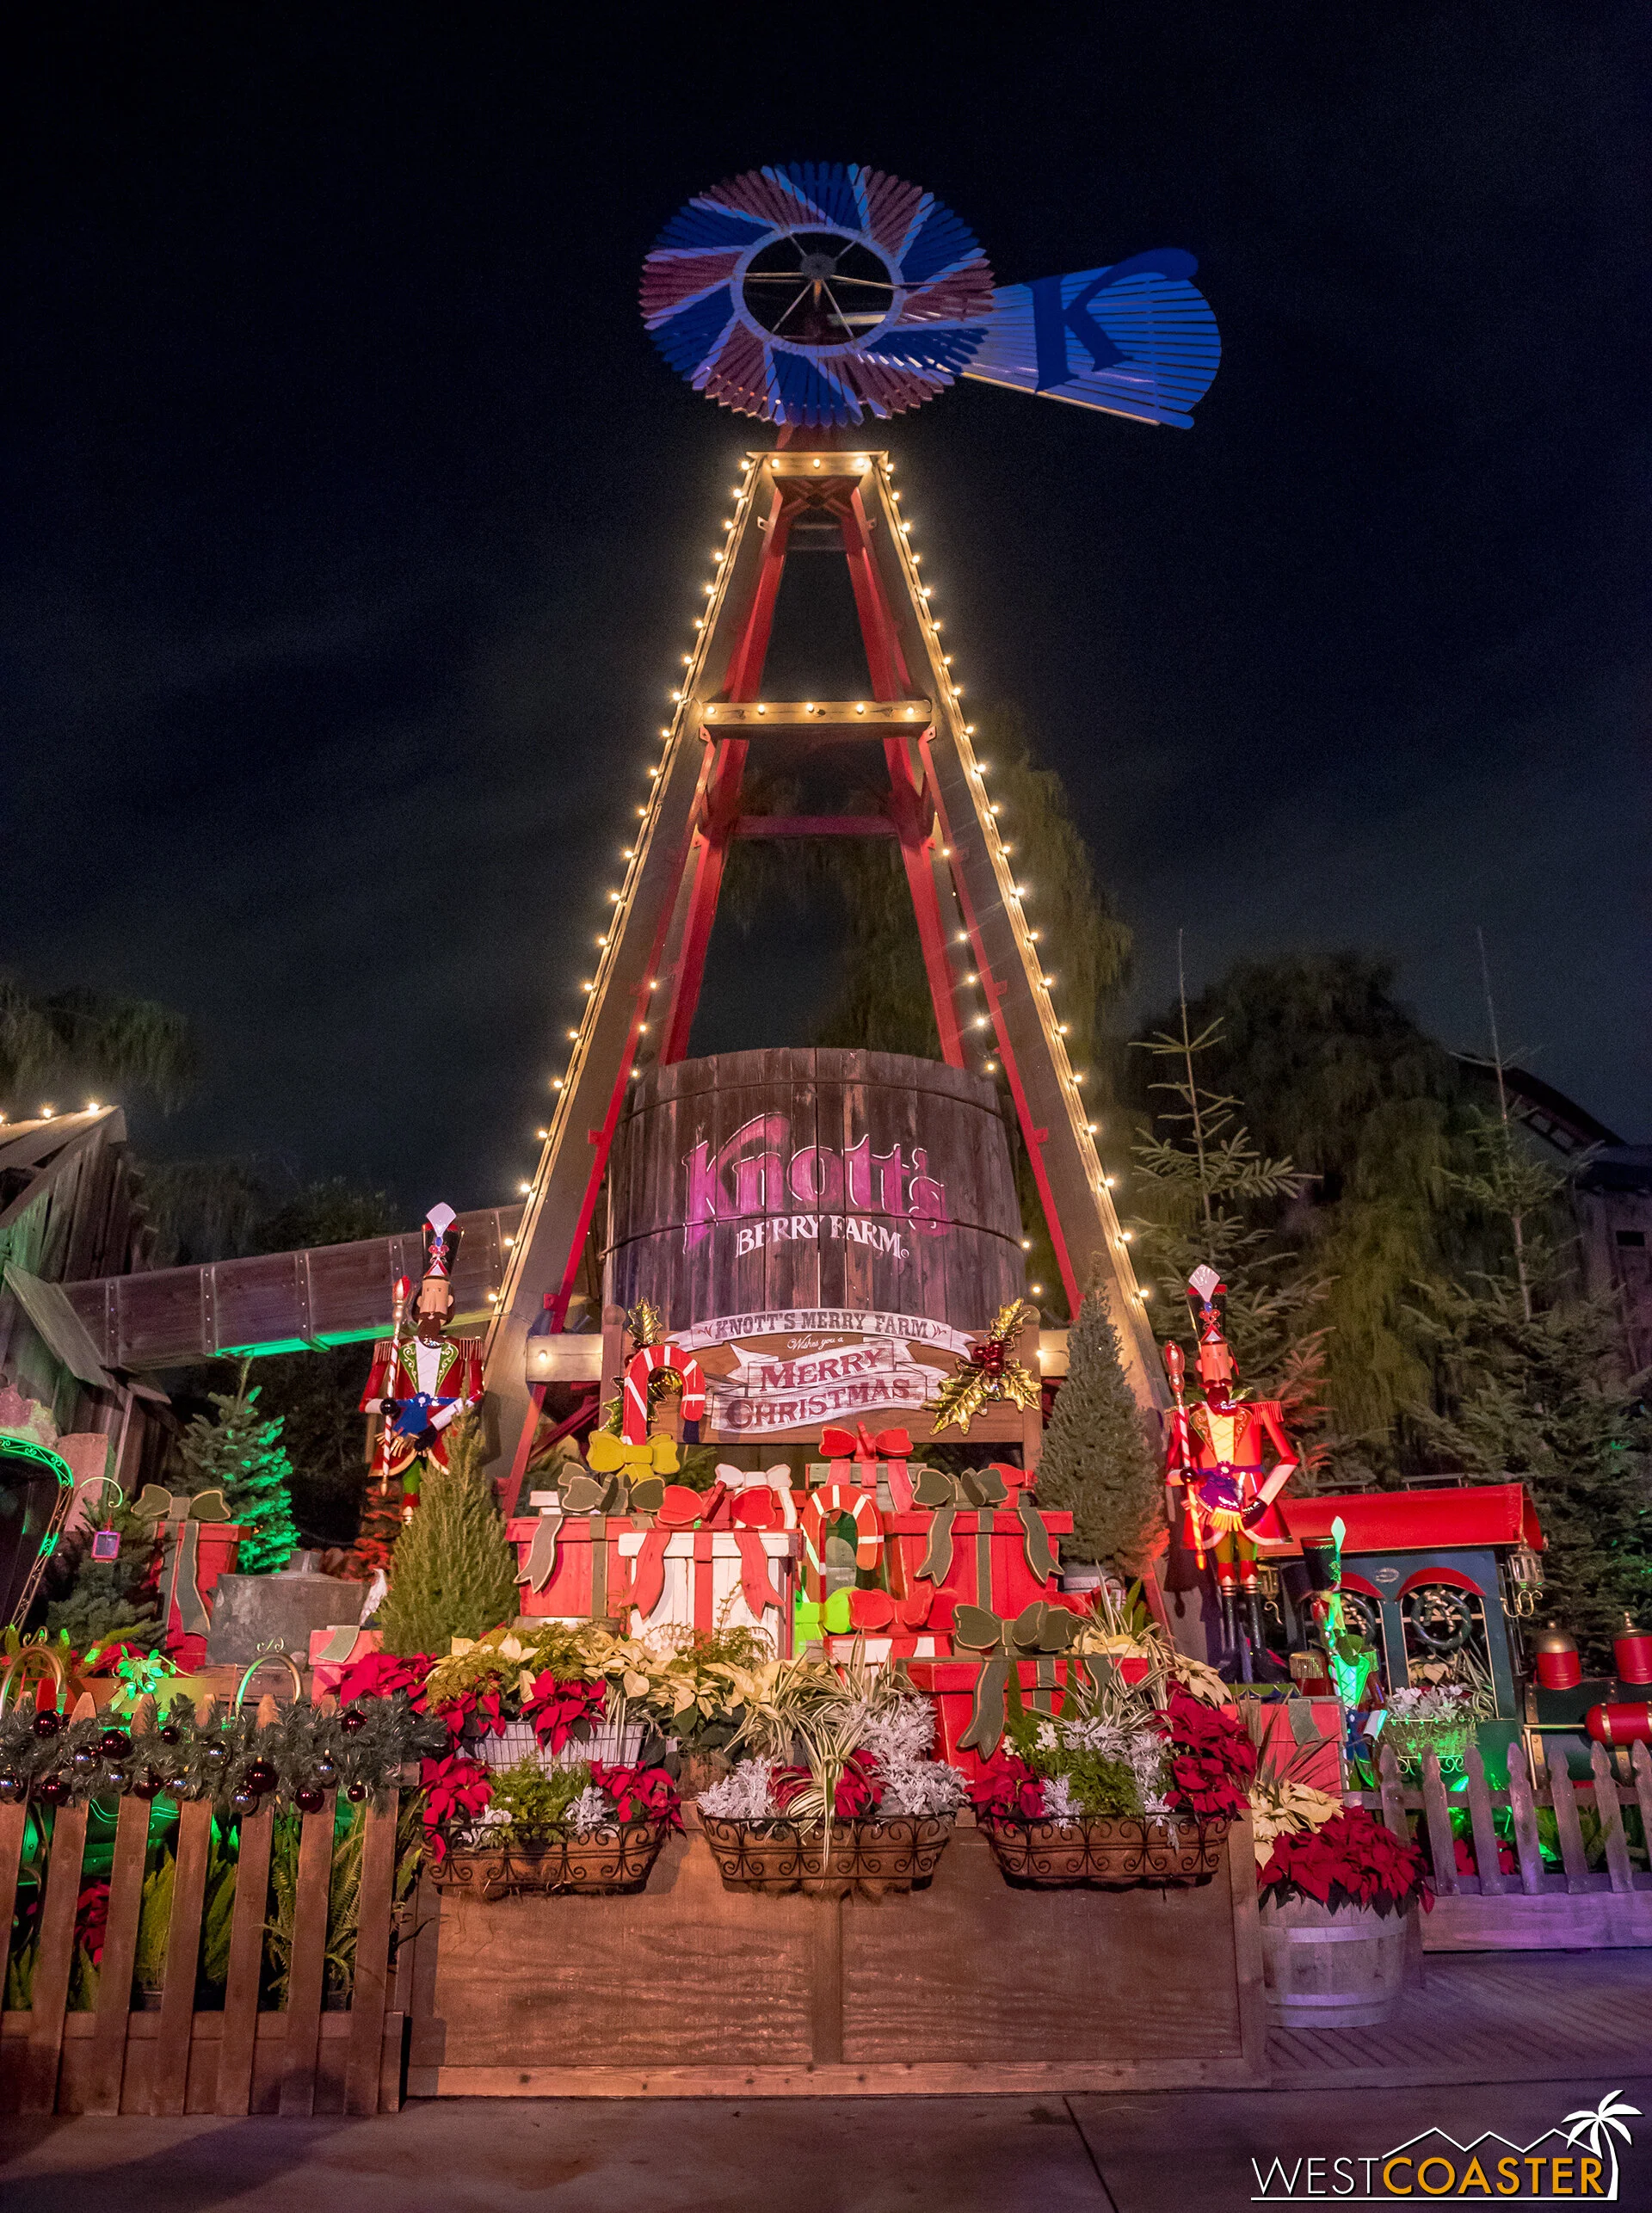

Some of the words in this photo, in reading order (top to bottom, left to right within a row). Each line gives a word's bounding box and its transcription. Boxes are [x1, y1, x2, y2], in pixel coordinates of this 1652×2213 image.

[1024, 247, 1199, 394] K
[682, 1113, 949, 1254] Knott's
[736, 1214, 821, 1259] BERRY
[715, 1313, 797, 1339] KNOTT'S
[801, 1311, 866, 1332] MERRY
[874, 1316, 929, 1338] FARM
[786, 1335, 819, 1350] Wishes
[818, 1338, 836, 1350] you
[761, 1348, 885, 1391] MERRY
[726, 1378, 910, 1428] CHRISTMAS
